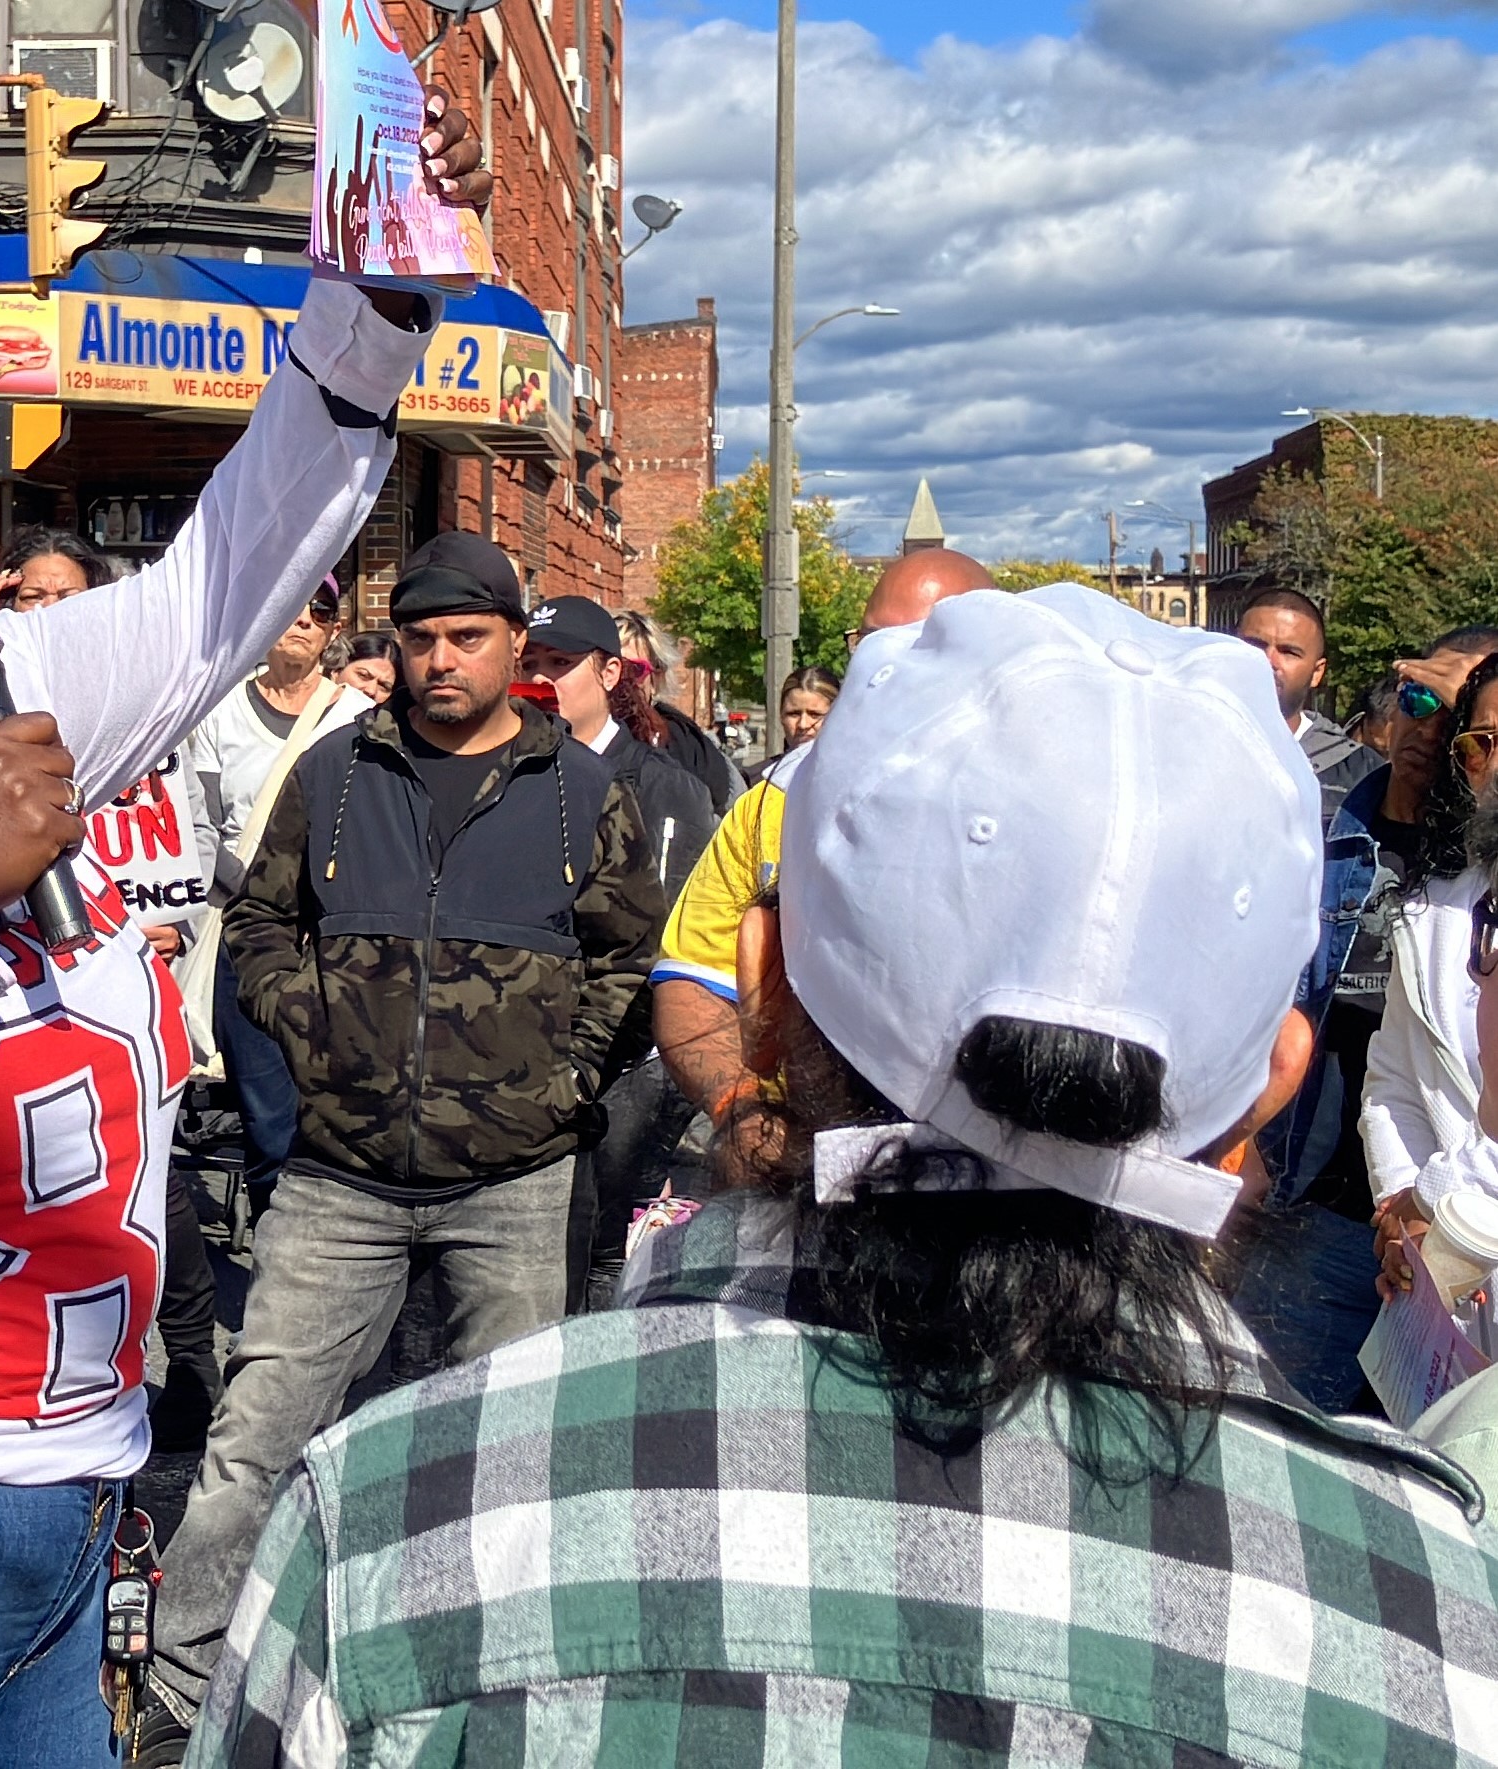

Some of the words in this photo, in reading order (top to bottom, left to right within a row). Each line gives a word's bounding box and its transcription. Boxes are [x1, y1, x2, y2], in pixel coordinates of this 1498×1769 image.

[77, 300, 246, 375] Almonte
[65, 371, 92, 389] 129
[94, 376, 136, 391] SARGEANT
[173, 378, 198, 396] WE
[201, 380, 263, 399] ACCEPT
[438, 336, 480, 390] #2
[399, 392, 491, 414] -315-3665
[92, 802, 183, 867] UN
[114, 877, 208, 912] ENCE
